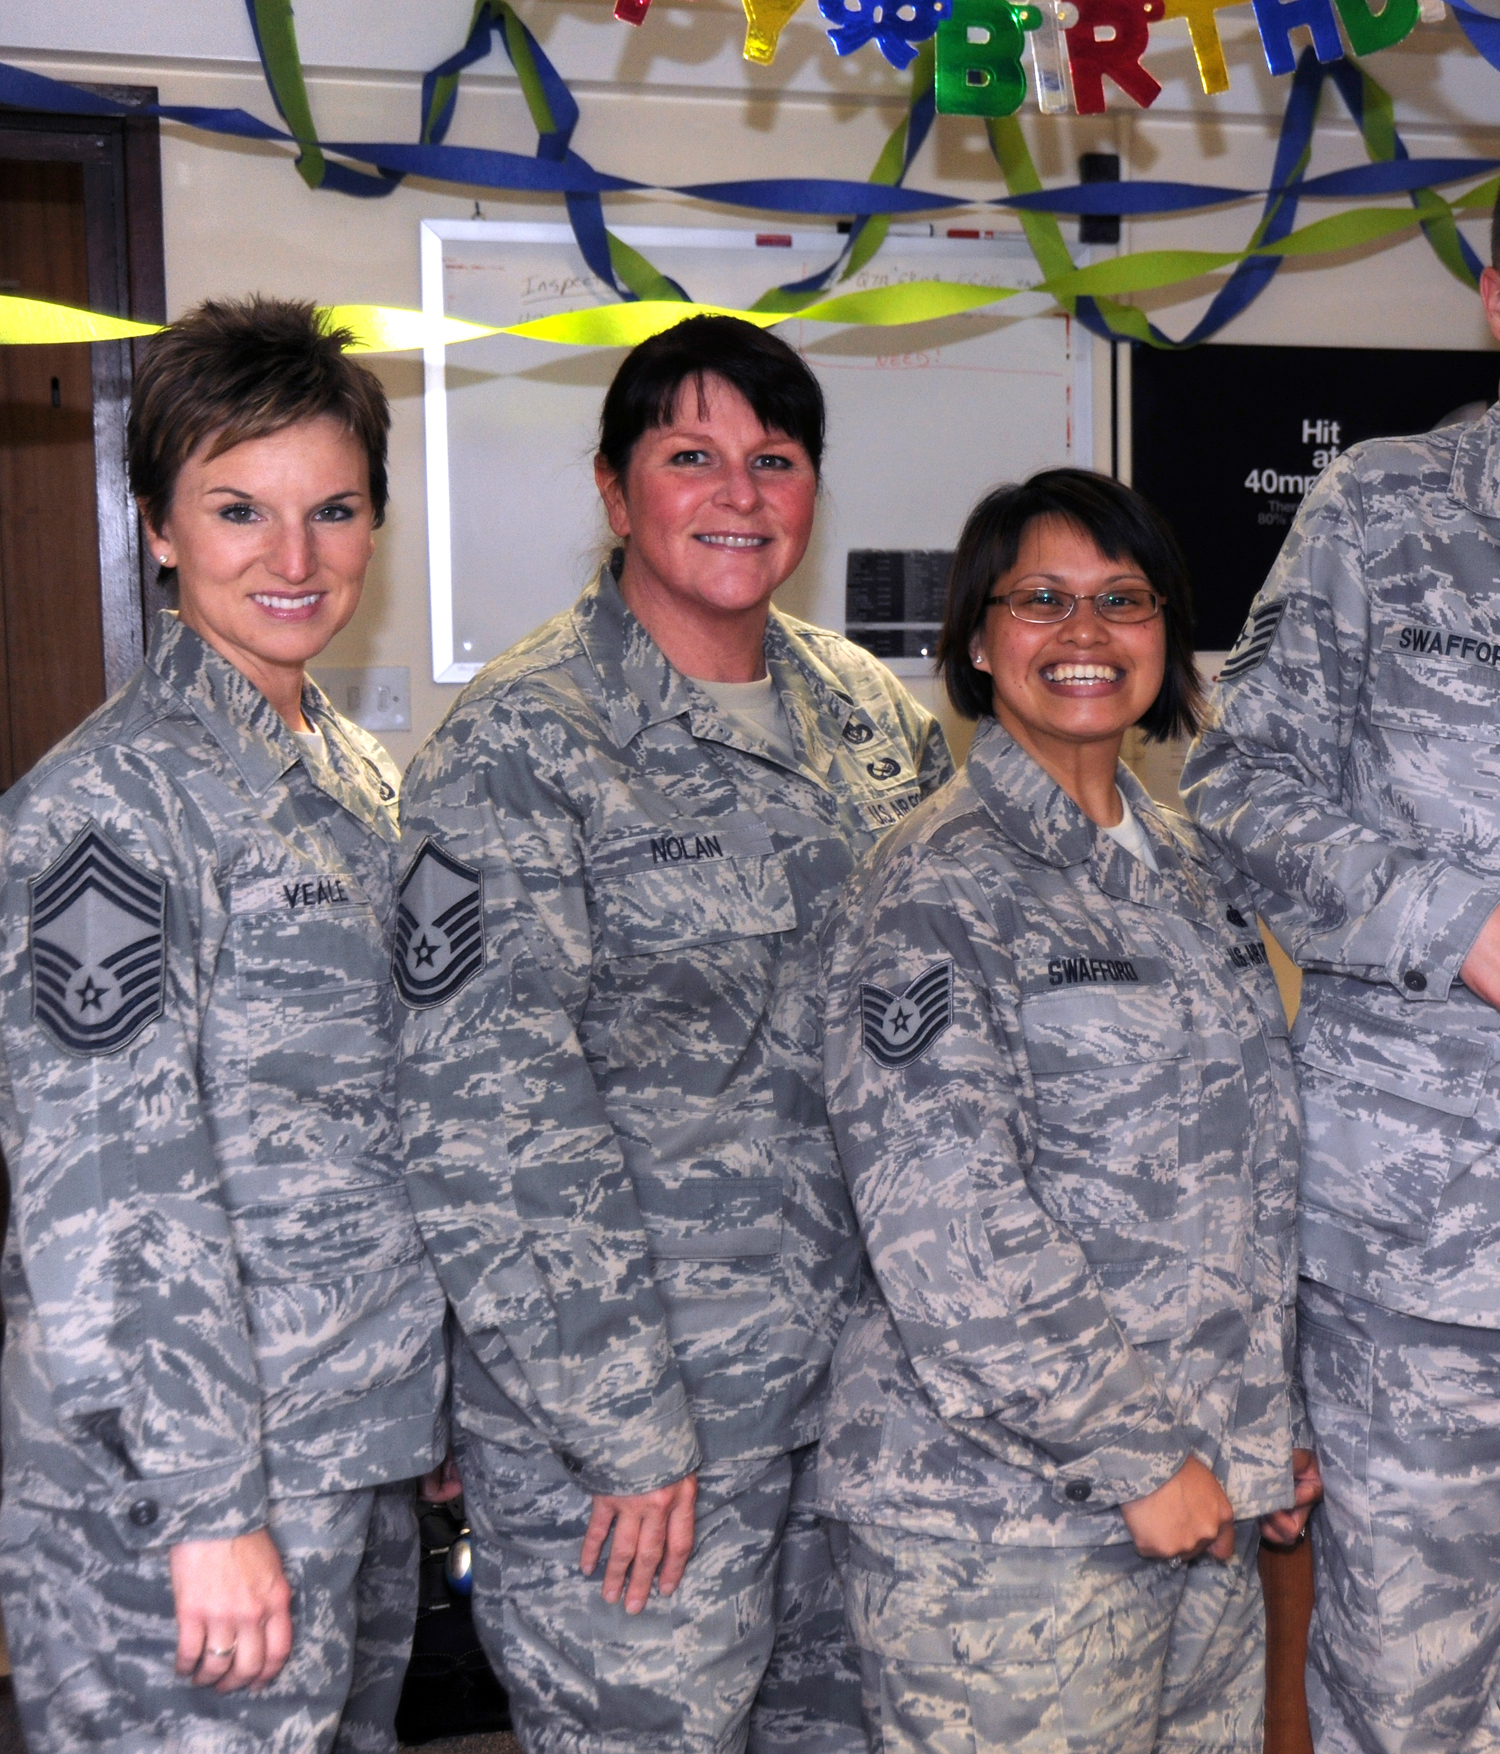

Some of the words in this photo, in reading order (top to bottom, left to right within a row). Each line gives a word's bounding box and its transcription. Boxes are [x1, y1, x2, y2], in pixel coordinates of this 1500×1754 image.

[1301, 419, 1341, 444] Hit
[1244, 469, 1319, 494] 40mp
[650, 835, 723, 864] NOLAN
[283, 880, 349, 909] VEALE
[1048, 957, 1139, 986] SWAFFORD
